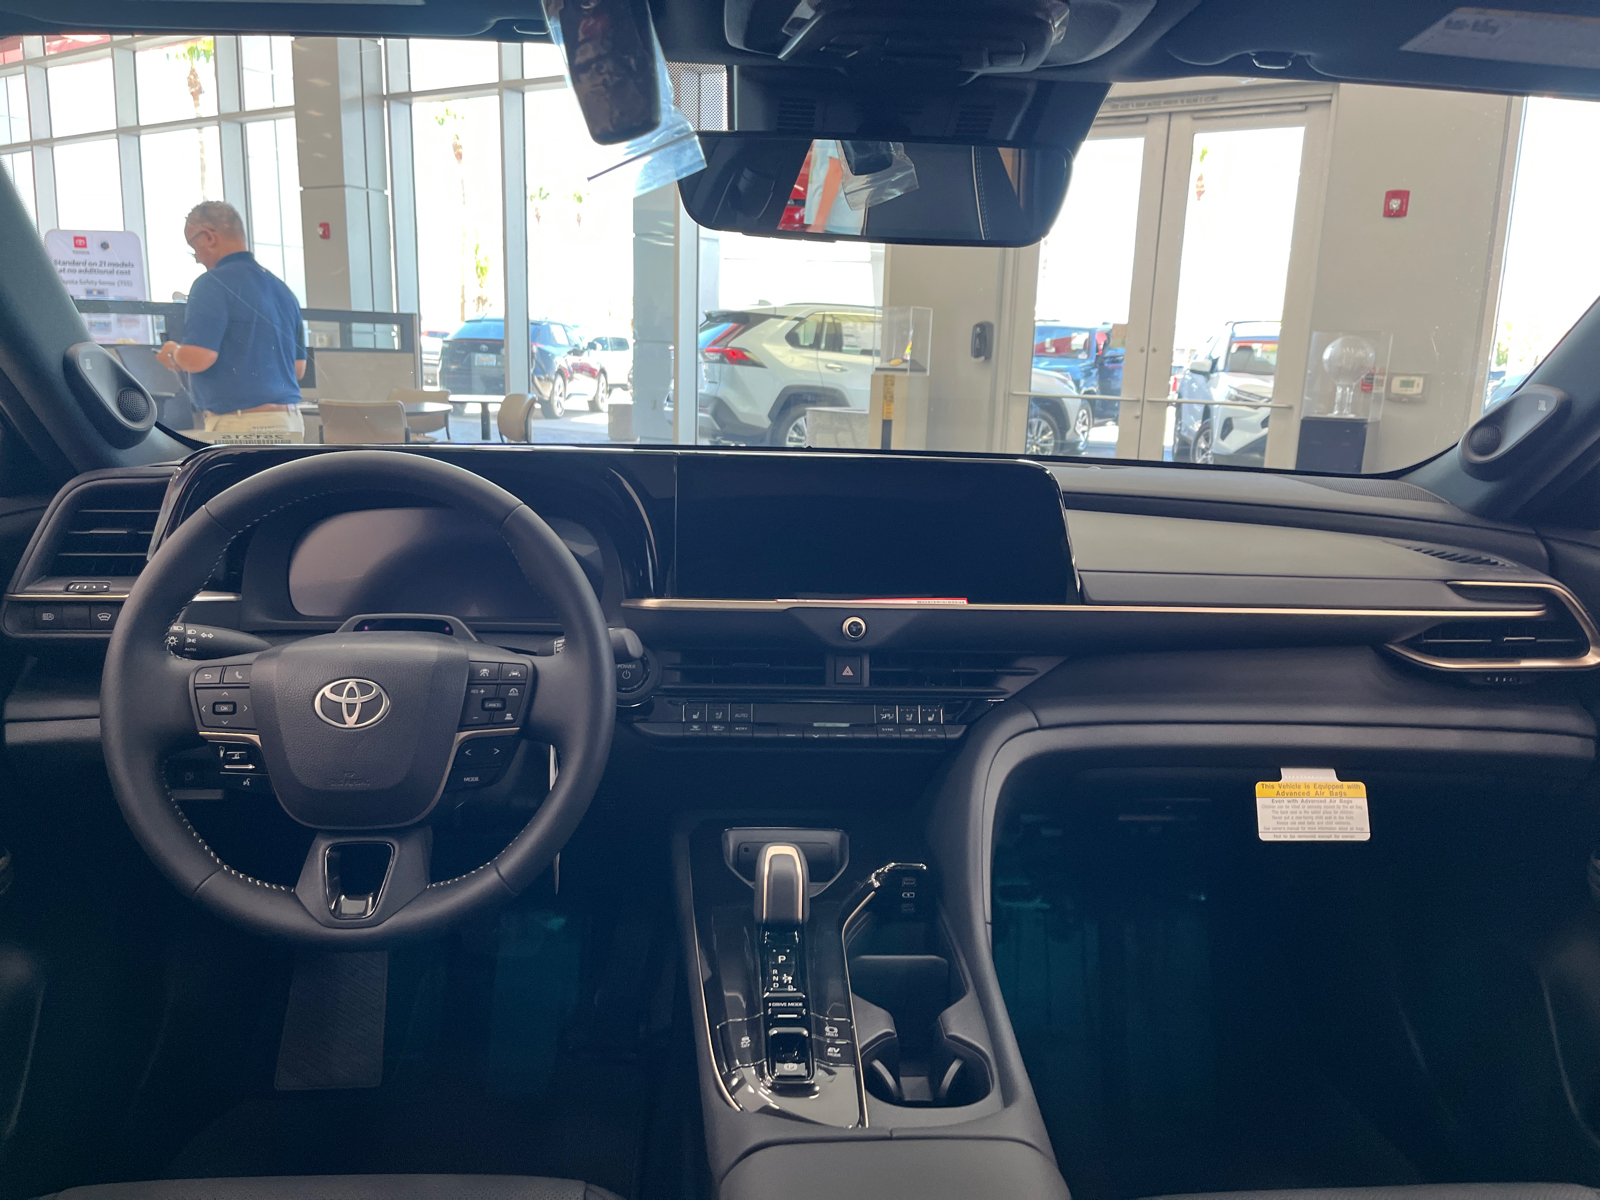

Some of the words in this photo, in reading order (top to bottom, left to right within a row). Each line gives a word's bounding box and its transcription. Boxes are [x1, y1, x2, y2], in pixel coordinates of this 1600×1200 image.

[54, 259, 87, 267] Standard
[1314, 783, 1344, 791] Equipped
[778, 955, 786, 964] P
